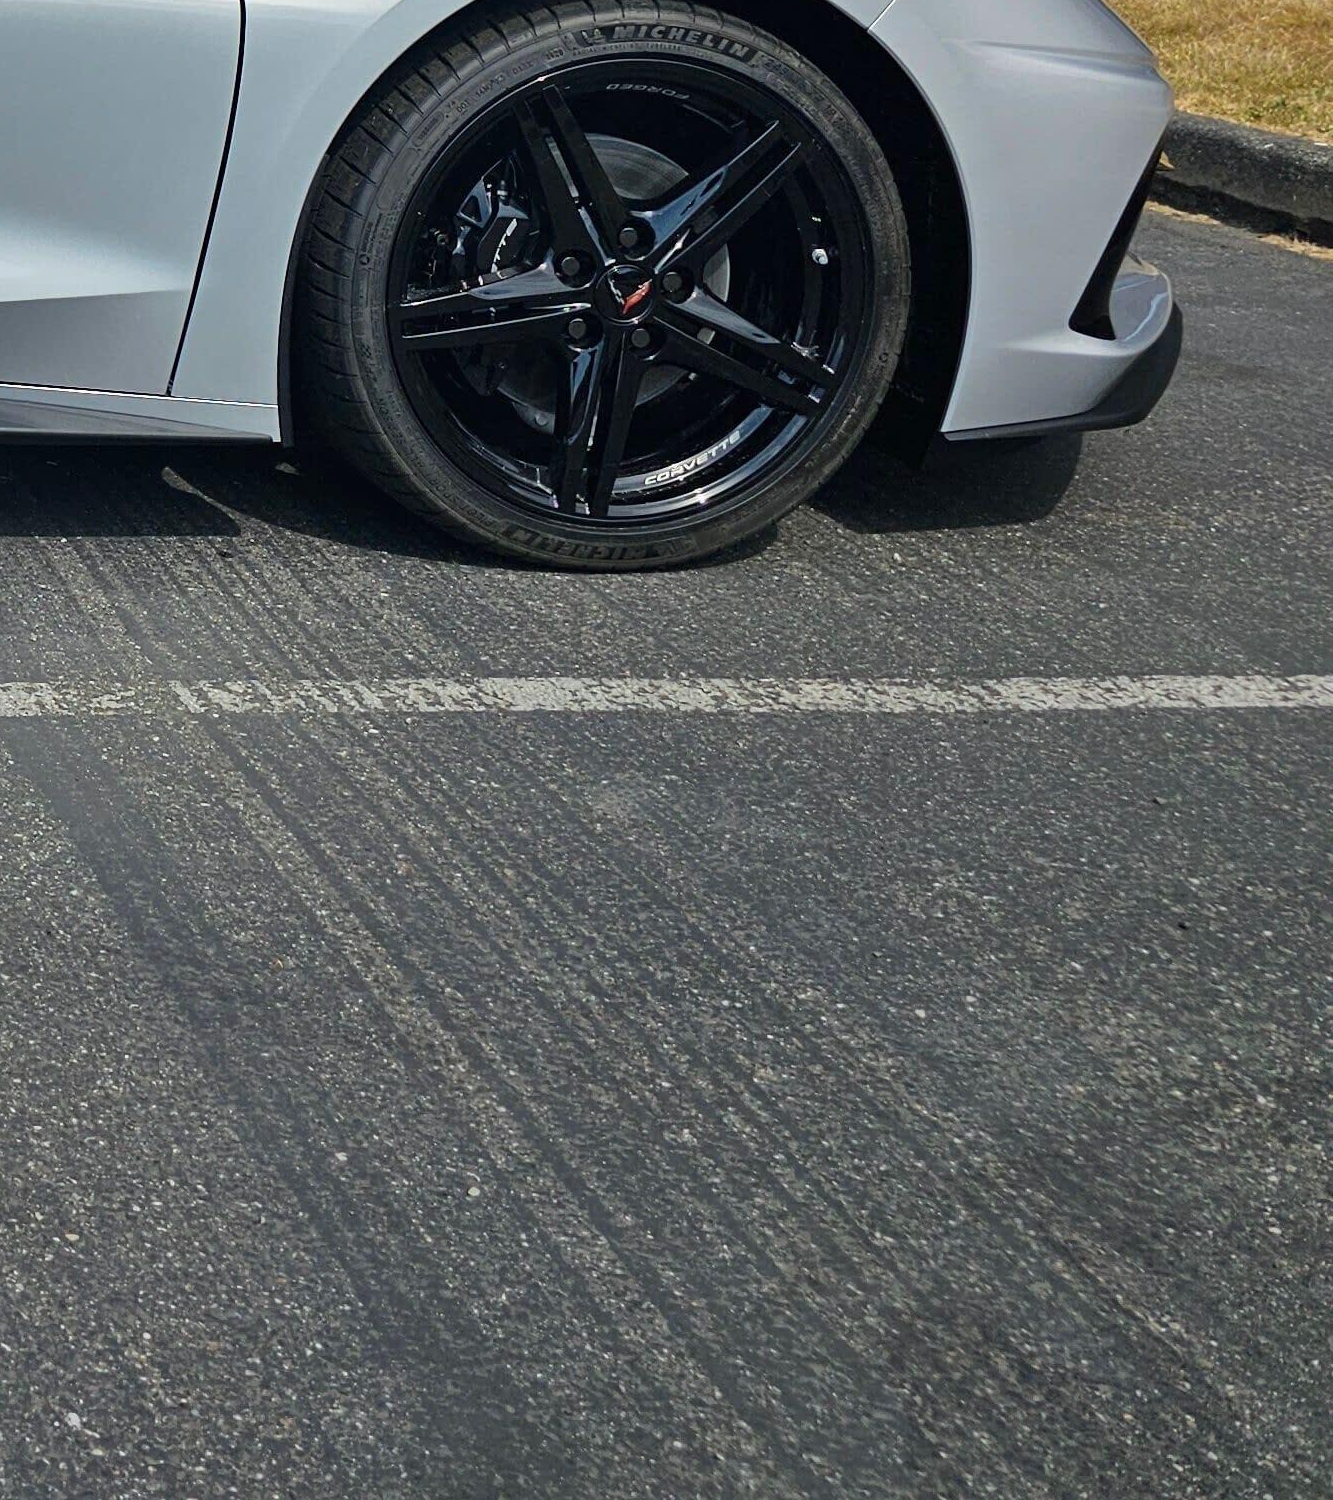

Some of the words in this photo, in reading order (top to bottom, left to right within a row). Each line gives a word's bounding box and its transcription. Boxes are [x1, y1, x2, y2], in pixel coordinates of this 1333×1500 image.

[612, 25, 750, 58] MICHELIN
[606, 83, 690, 100] FORGED
[644, 430, 741, 485] CORVETTE
